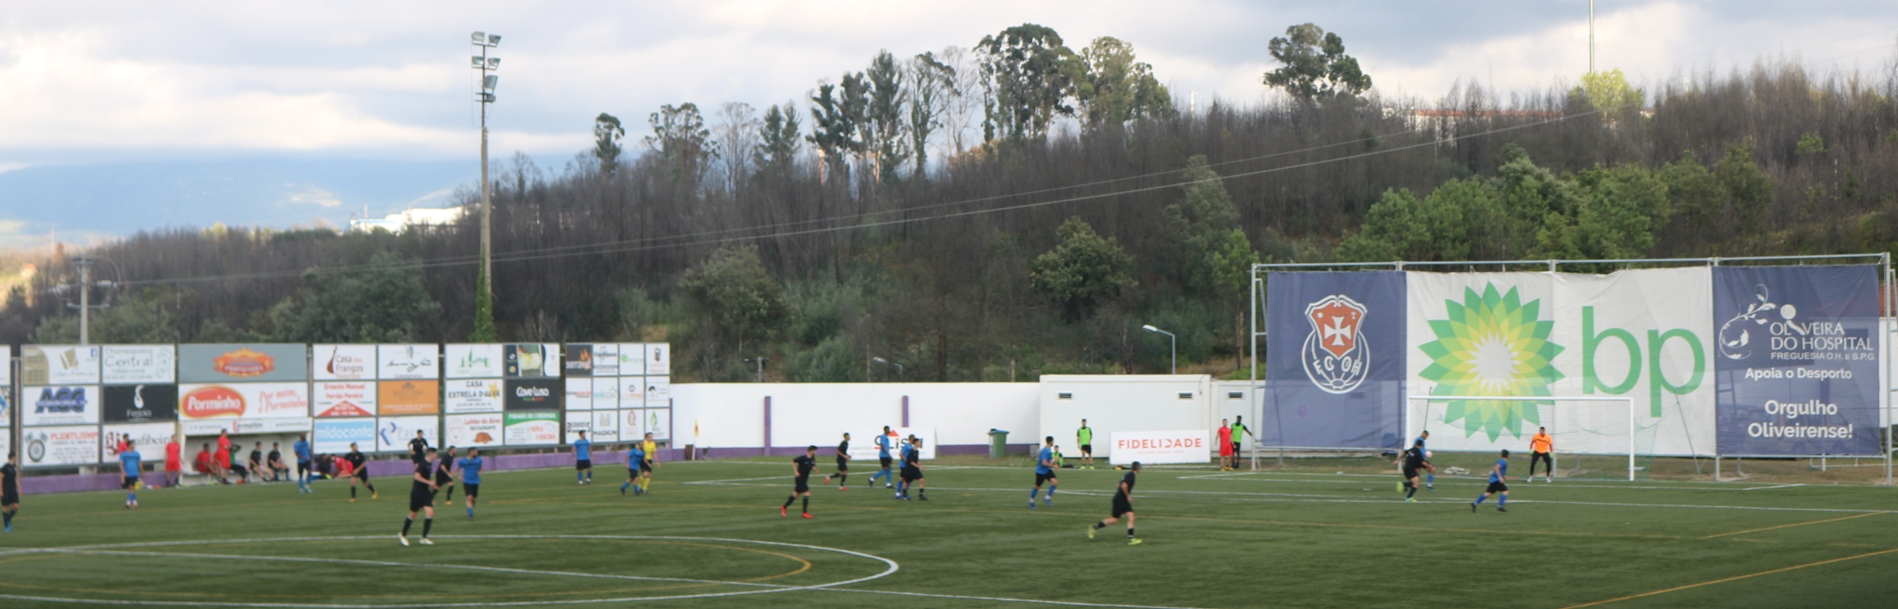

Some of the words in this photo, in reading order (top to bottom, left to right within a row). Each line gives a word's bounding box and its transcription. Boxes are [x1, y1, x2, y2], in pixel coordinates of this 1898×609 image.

[1771, 337, 1798, 351] DO
[1801, 337, 1874, 351] HOSPITAL
[105, 353, 153, 367] Central
[336, 355, 352, 363] Casa
[1582, 306, 1706, 418] bp
[1770, 352, 1825, 360] FREGUESIA
[336, 364, 363, 374] Frangos
[1745, 367, 1783, 381] Apoia
[1785, 371, 1794, 379] o
[1797, 367, 1852, 381] Desporto
[187, 395, 241, 412] Porminho
[1764, 399, 1838, 419] Orgulho
[316, 425, 374, 438] midoconta
[1747, 422, 1853, 438] Oliveirense!
[1118, 437, 1202, 449] FIDELIDADE
